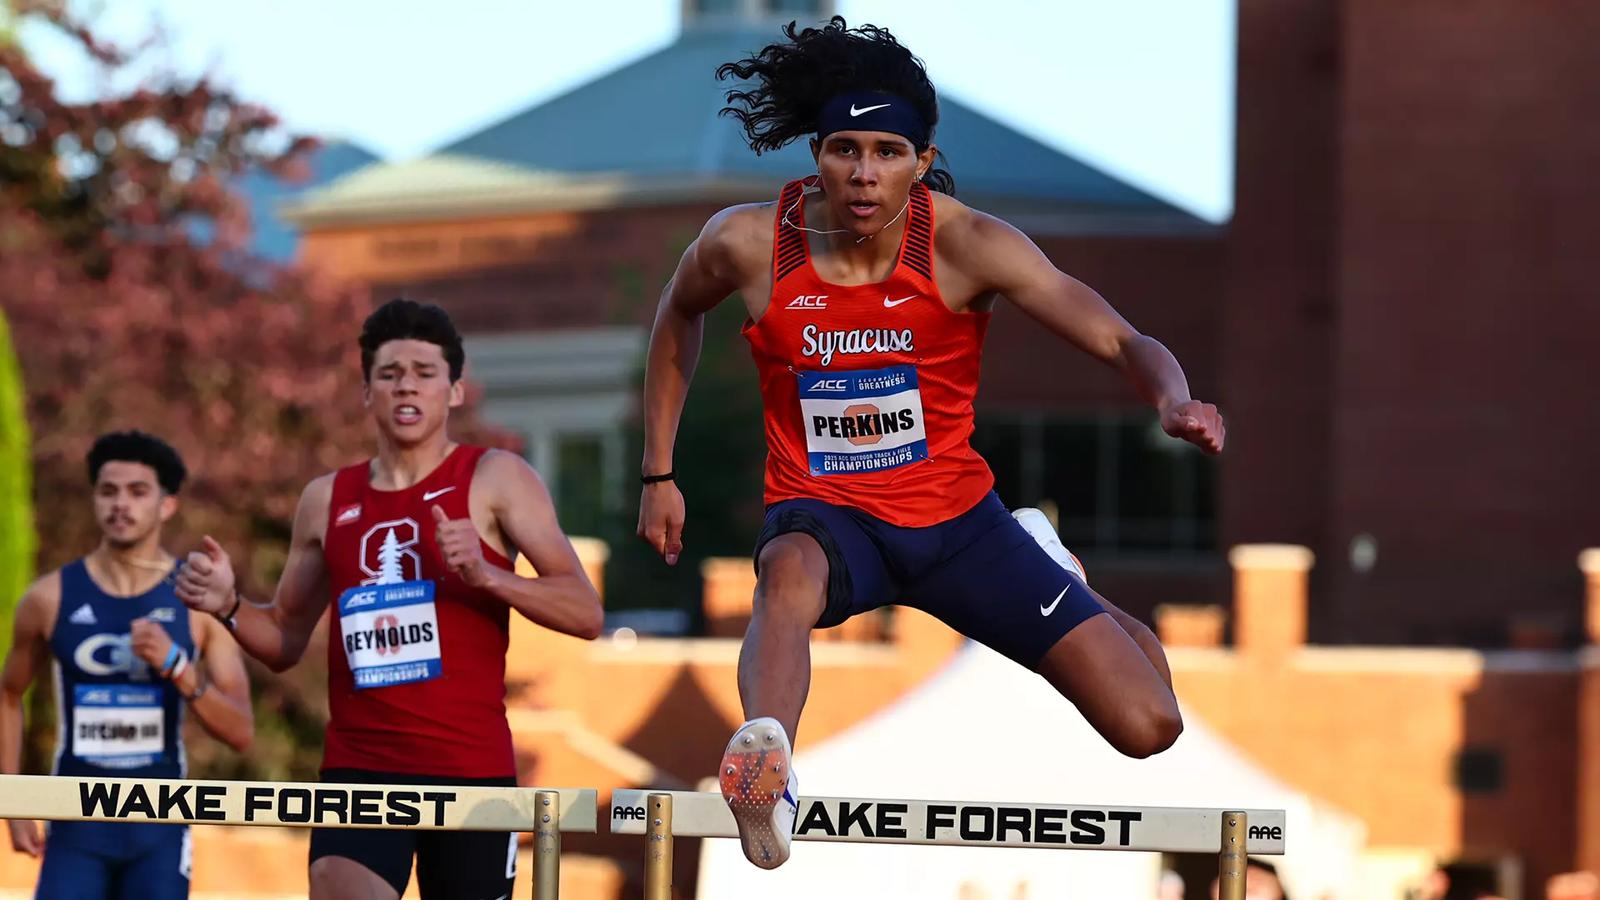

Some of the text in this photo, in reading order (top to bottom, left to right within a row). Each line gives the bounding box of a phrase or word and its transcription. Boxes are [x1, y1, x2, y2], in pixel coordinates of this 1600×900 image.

[787, 295, 829, 309] ACC
[801, 324, 914, 367] Syracuse
[808, 379, 849, 391] ACC
[858, 376, 906, 390] GREATNESS
[813, 408, 915, 438] PERKINS
[824, 451, 913, 471] CHAMPIONSHIPS
[849, 453, 874, 461] OUTDOOR
[874, 451, 891, 459] TRACK
[79, 782, 457, 827] WAKE FOREST
[792, 800, 1142, 846] AKE FOREST
